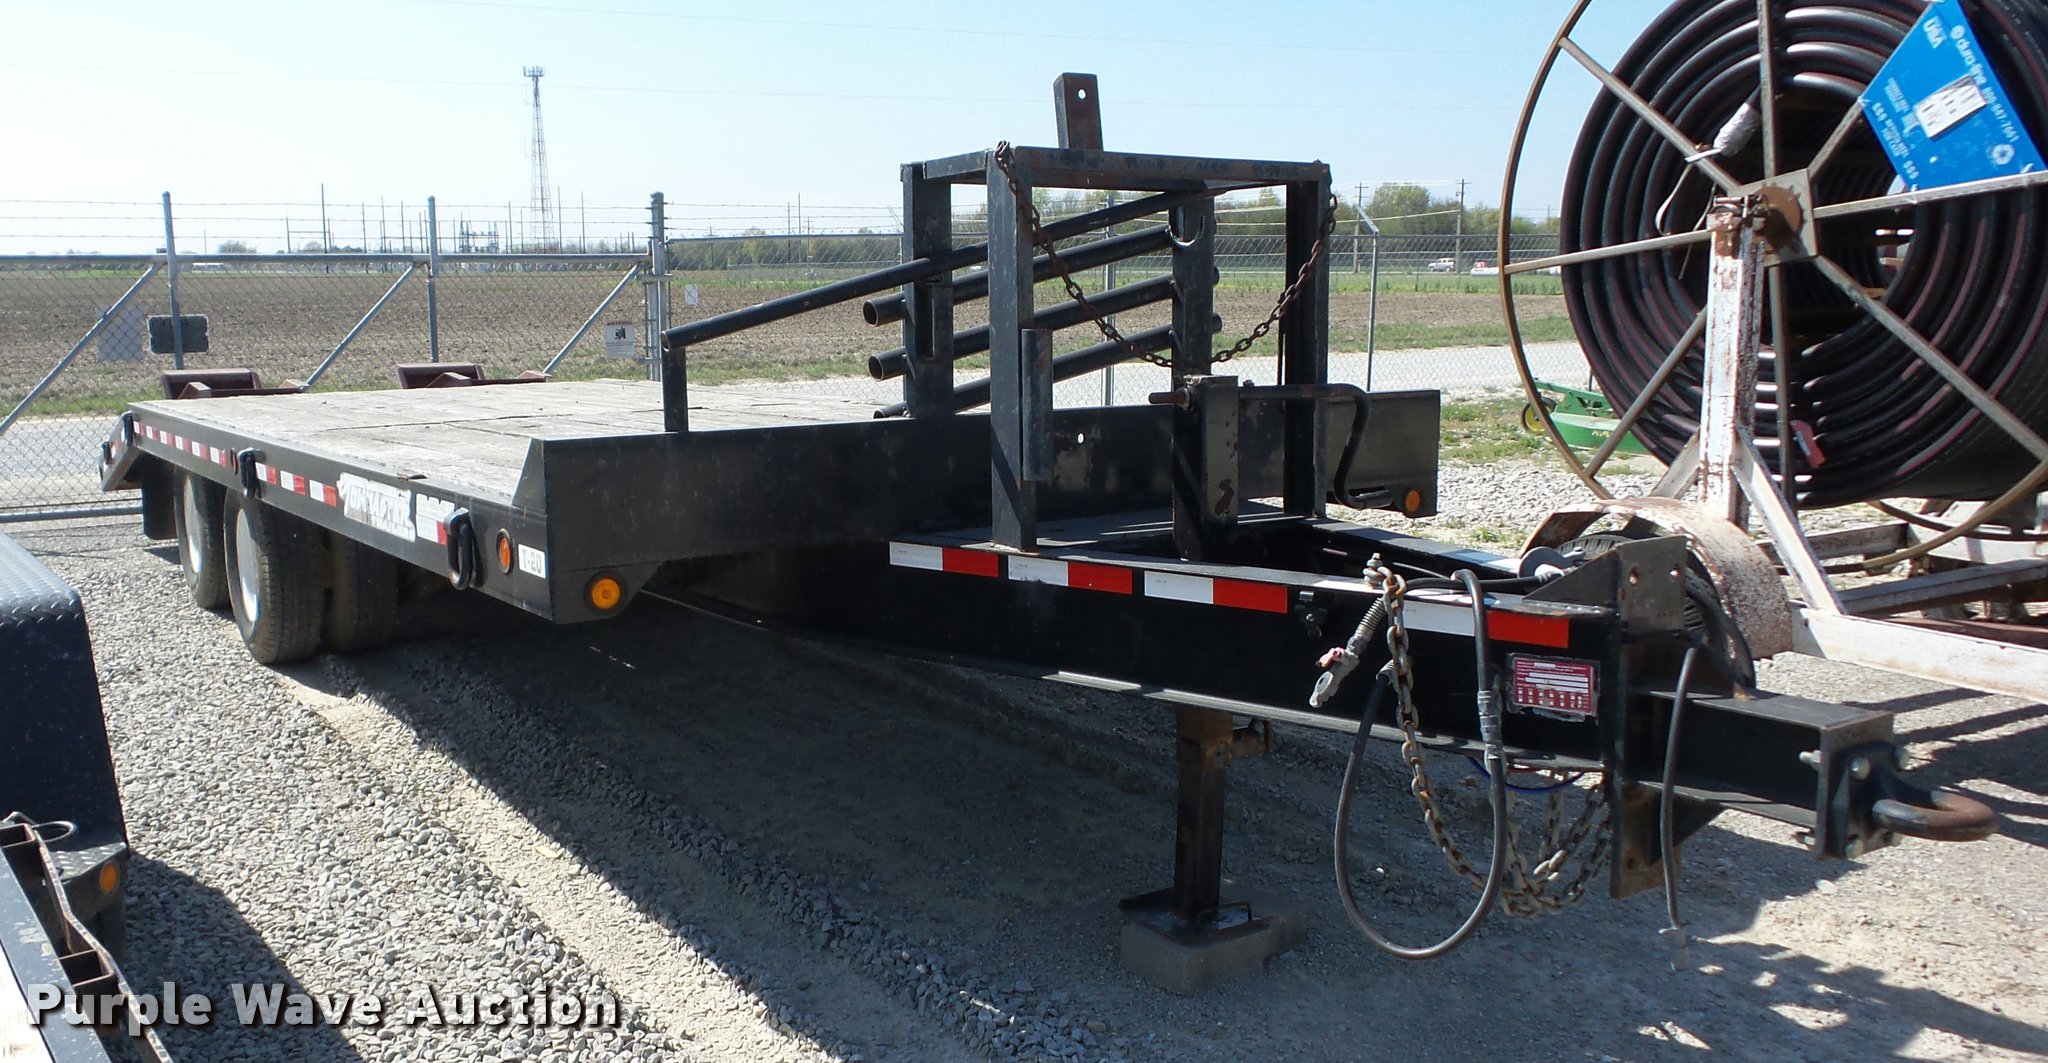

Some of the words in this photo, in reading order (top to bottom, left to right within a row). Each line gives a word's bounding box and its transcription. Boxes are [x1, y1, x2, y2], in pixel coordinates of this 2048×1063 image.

[1923, 18, 1946, 48] USA
[1955, 38, 1987, 86] dura-line
[521, 548, 542, 574] T-20
